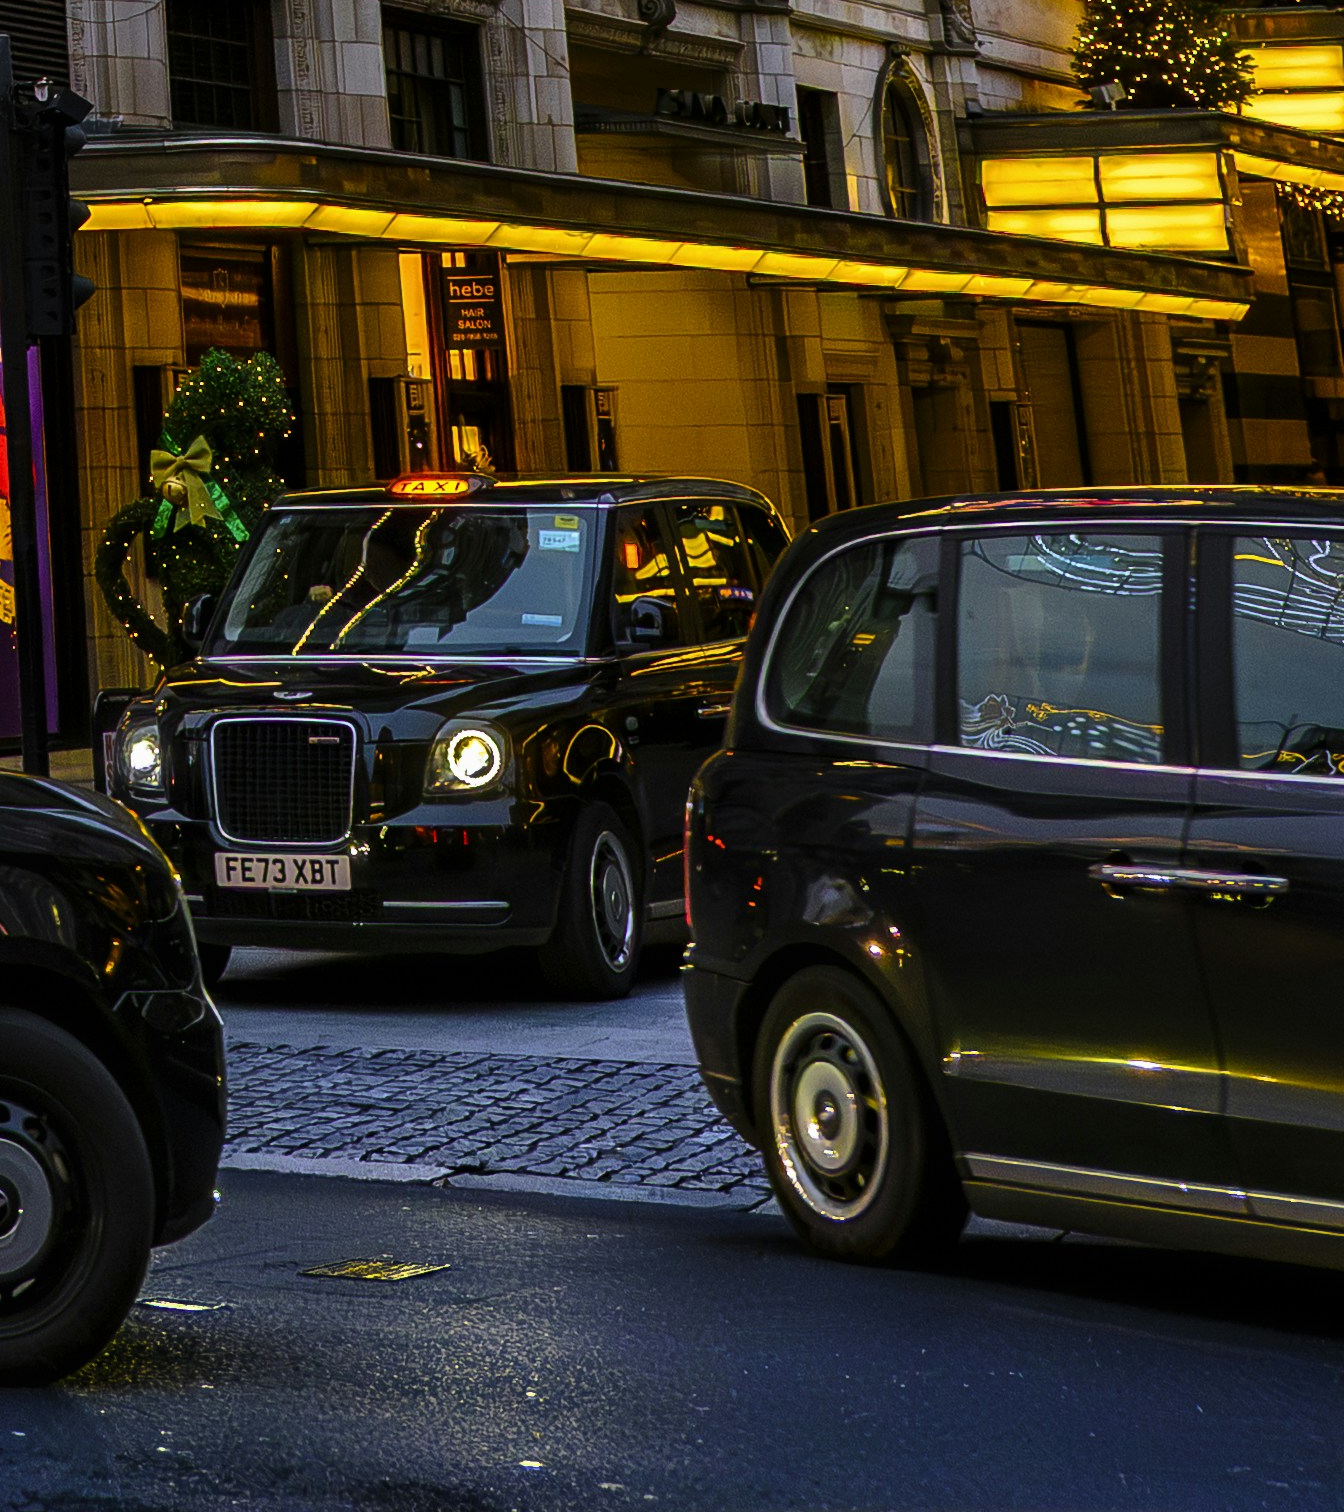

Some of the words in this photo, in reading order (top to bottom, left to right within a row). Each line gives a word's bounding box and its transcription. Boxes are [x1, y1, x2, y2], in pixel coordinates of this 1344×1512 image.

[449, 281, 494, 297] hebe
[461, 307, 485, 317] HAIR
[457, 320, 491, 329] SALON
[401, 481, 461, 492] TAXI
[224, 856, 287, 884] FE73
[292, 858, 340, 886] XBT
